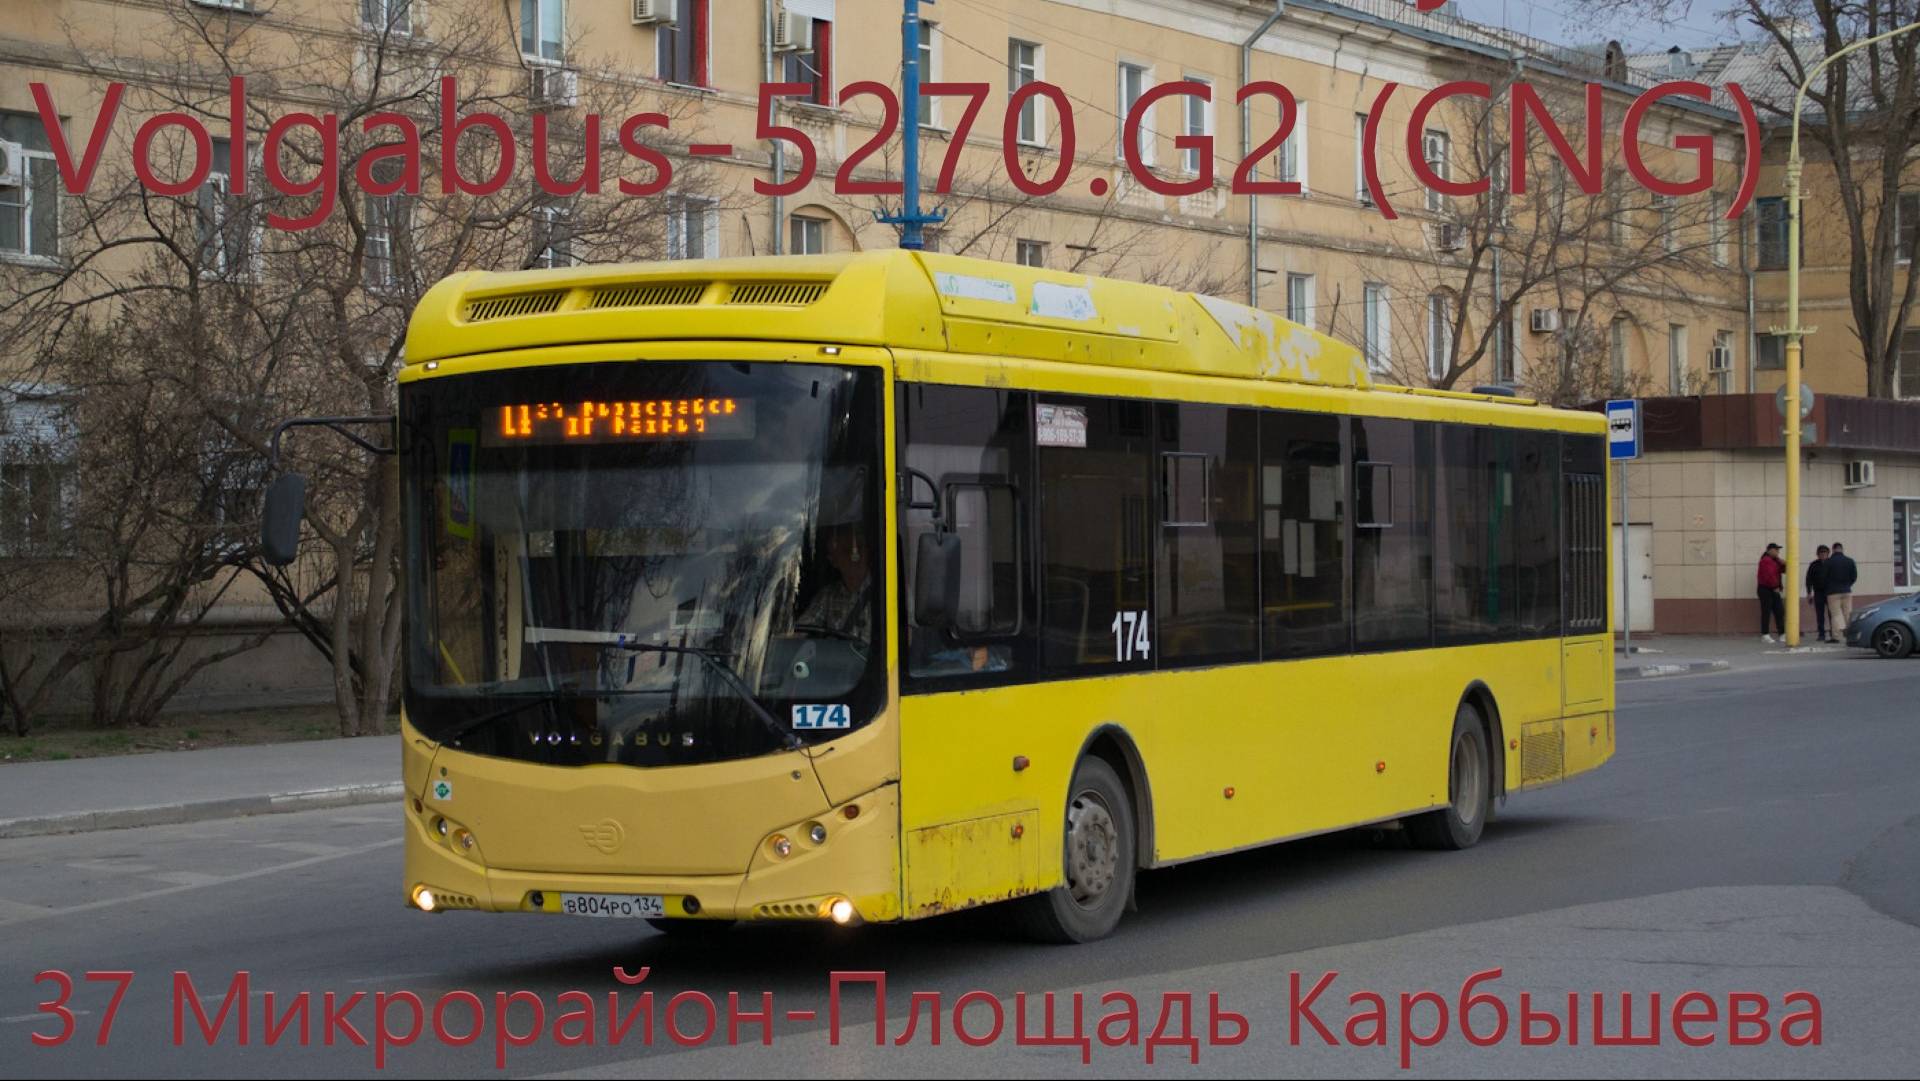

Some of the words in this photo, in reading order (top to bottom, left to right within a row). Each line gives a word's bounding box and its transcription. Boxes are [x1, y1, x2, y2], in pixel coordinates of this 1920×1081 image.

[1111, 610, 1150, 662] 174
[795, 704, 847, 728] 174
[529, 731, 695, 747] VOLGABUS
